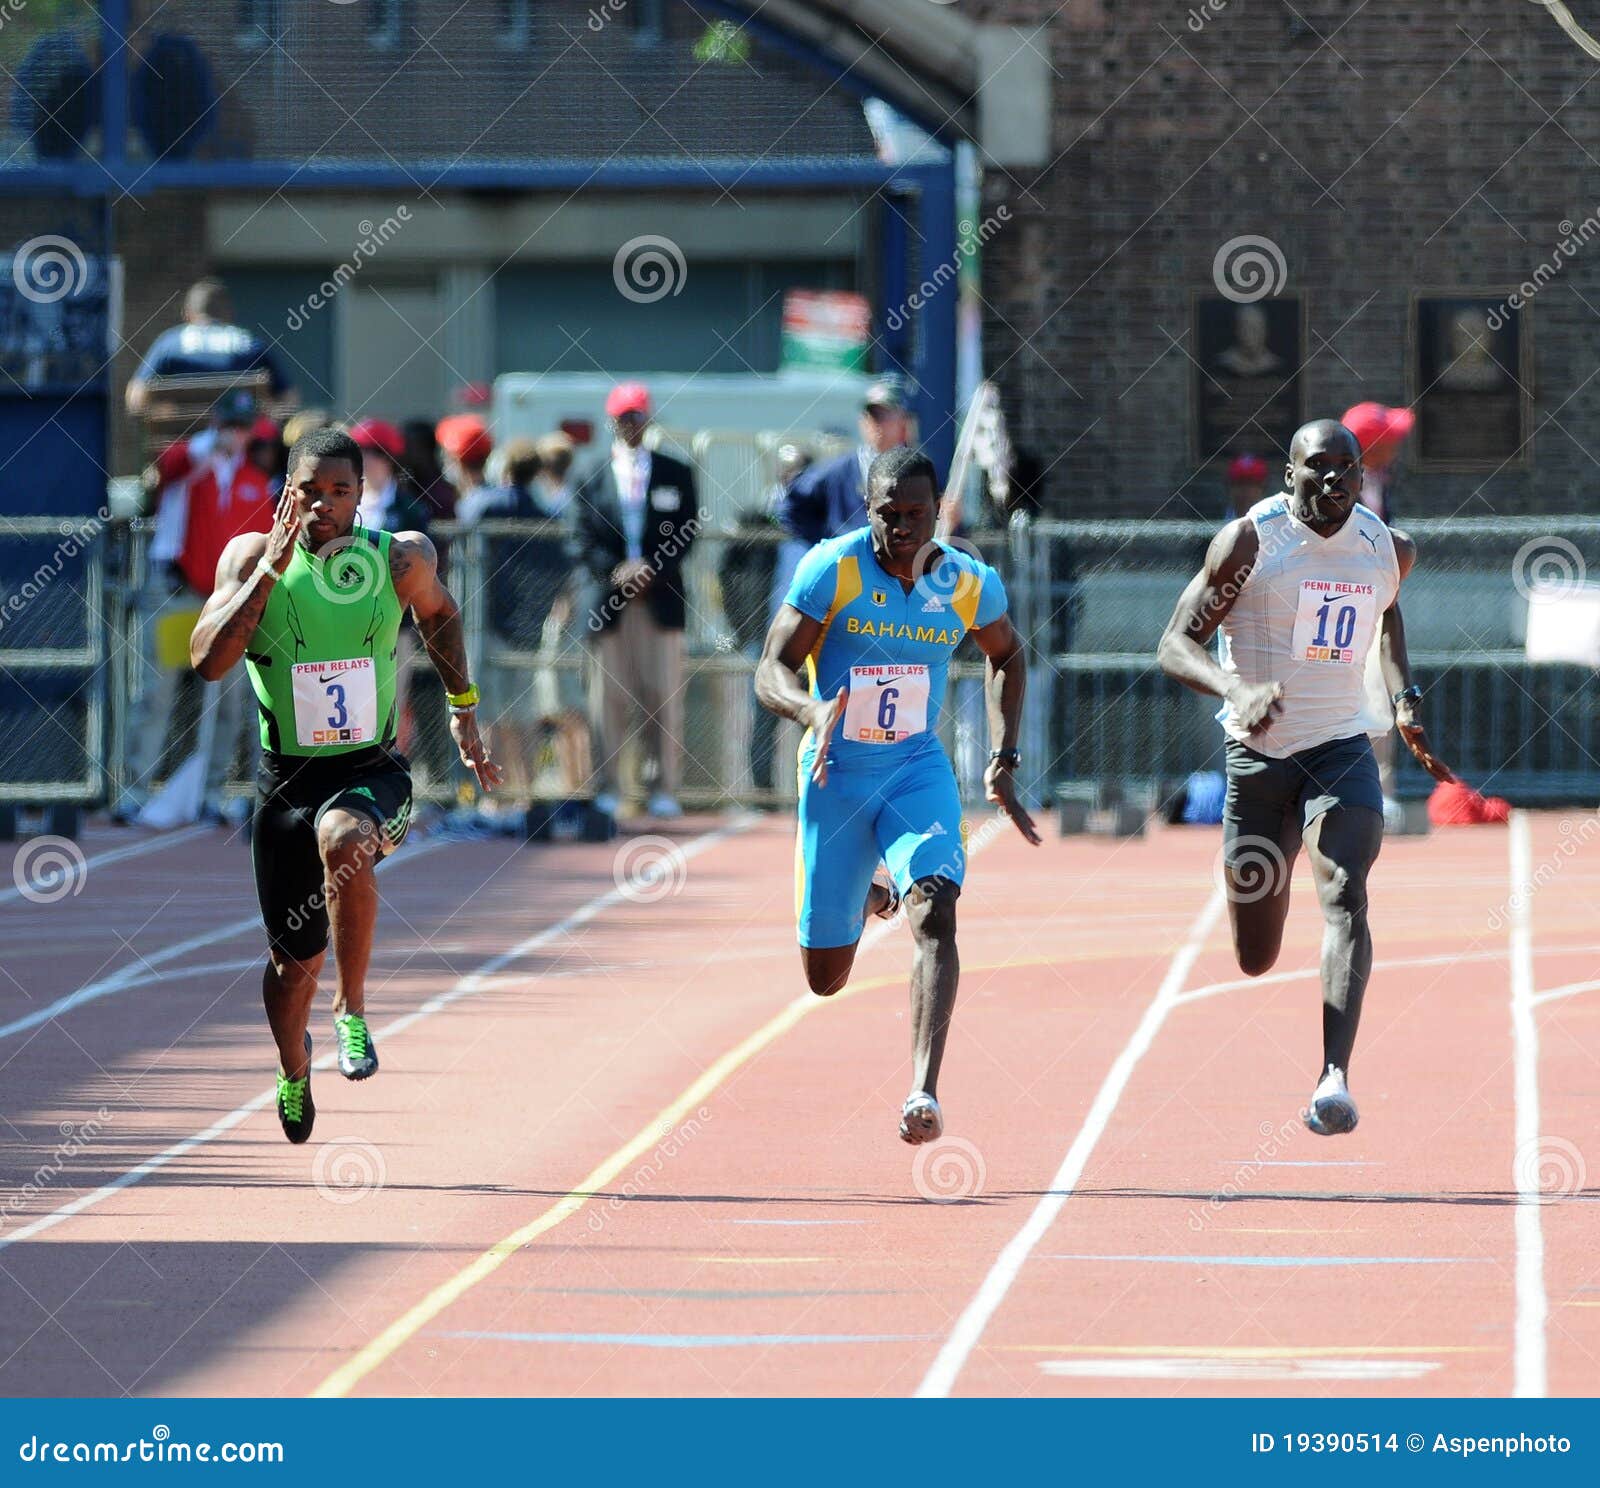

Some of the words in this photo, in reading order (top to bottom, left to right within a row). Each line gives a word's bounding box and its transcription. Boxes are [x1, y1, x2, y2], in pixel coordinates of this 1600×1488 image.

[1304, 581, 1331, 591] PENN
[1335, 583, 1373, 595] RELAYS
[847, 617, 960, 645] BAHAMAS
[1312, 604, 1357, 649] 10
[296, 663, 326, 674] PENN
[330, 659, 370, 671] RELAYS
[854, 666, 883, 676] PENN
[888, 666, 924, 675] RELAYS
[326, 684, 347, 729] 3
[877, 687, 899, 730] 6
